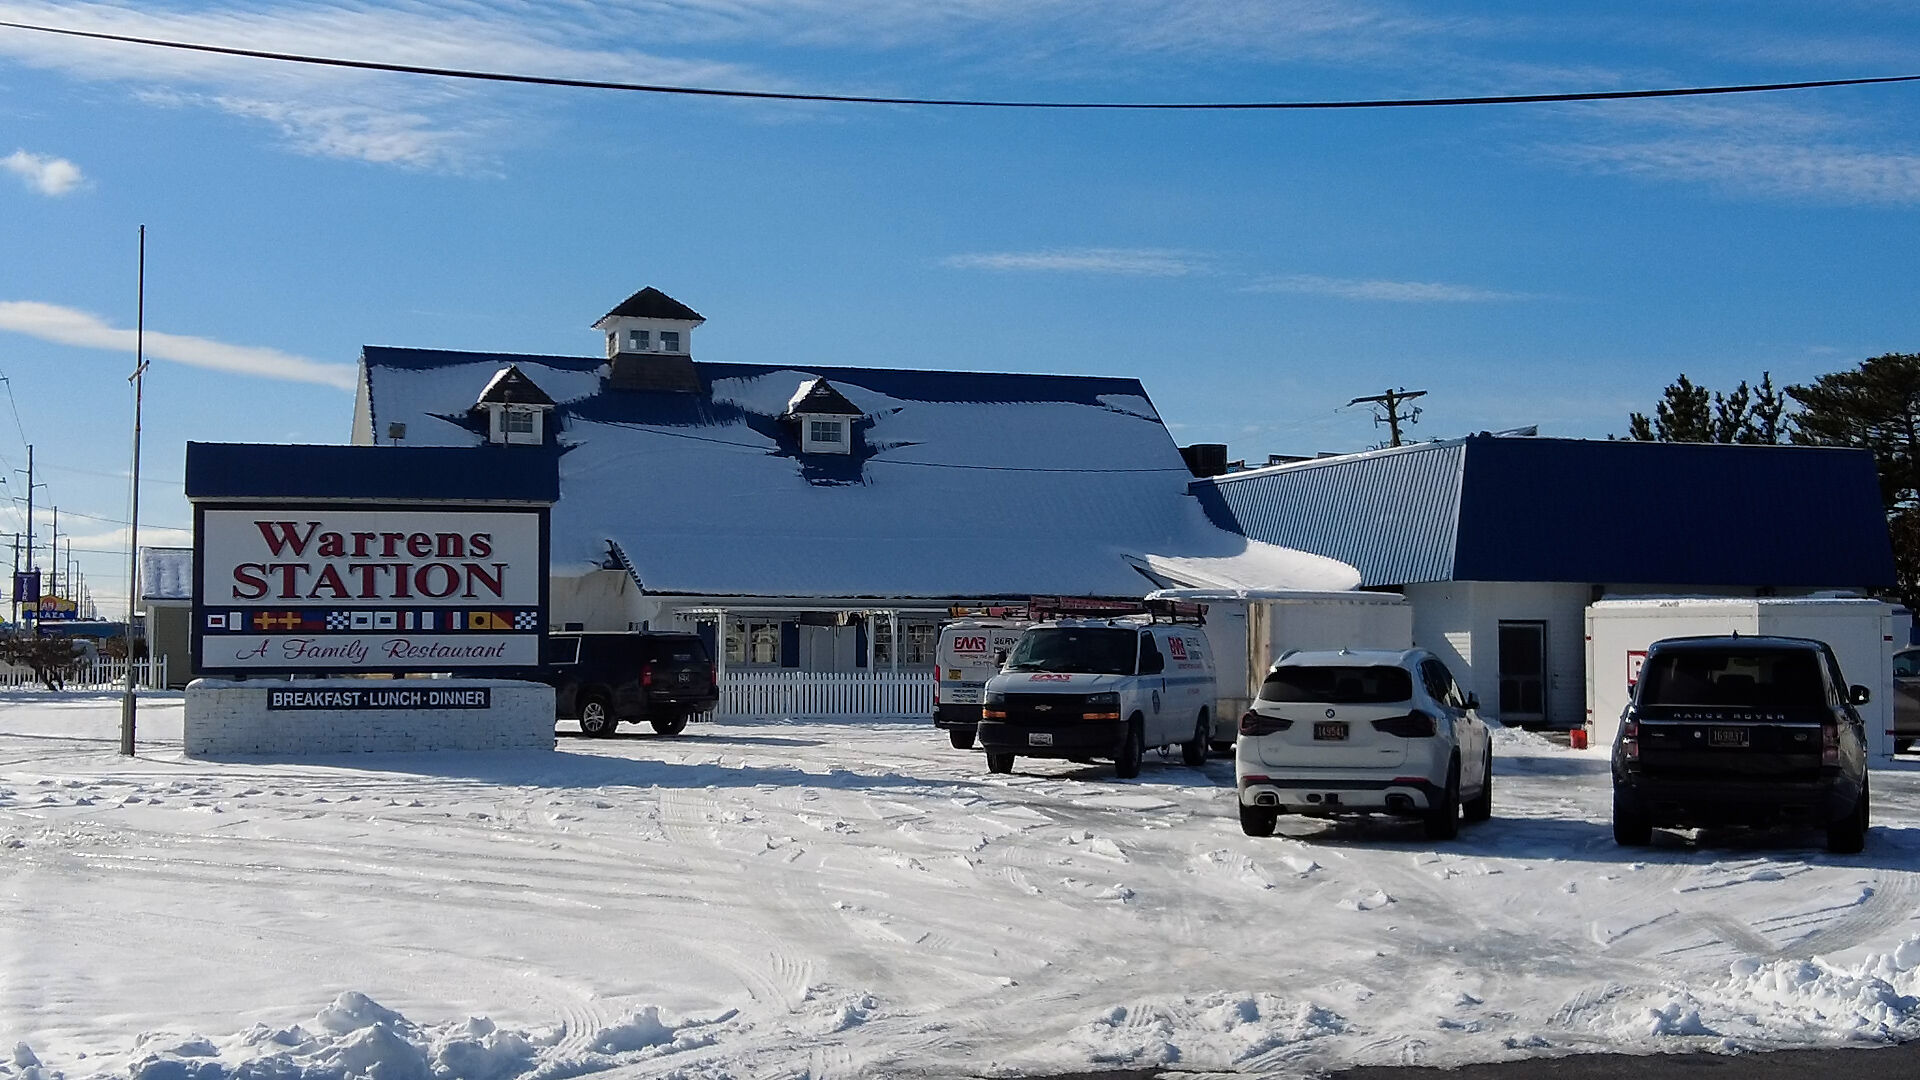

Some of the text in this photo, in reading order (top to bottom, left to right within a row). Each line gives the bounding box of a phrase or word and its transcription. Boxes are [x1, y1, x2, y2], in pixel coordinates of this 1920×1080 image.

[253, 520, 493, 558] Warrens
[232, 562, 511, 599] STATION
[236, 638, 508, 664] A Family Restaurant
[272, 691, 485, 707] BREAKFAST LUNCH DINNER
[1673, 712, 1723, 720] RANGE
